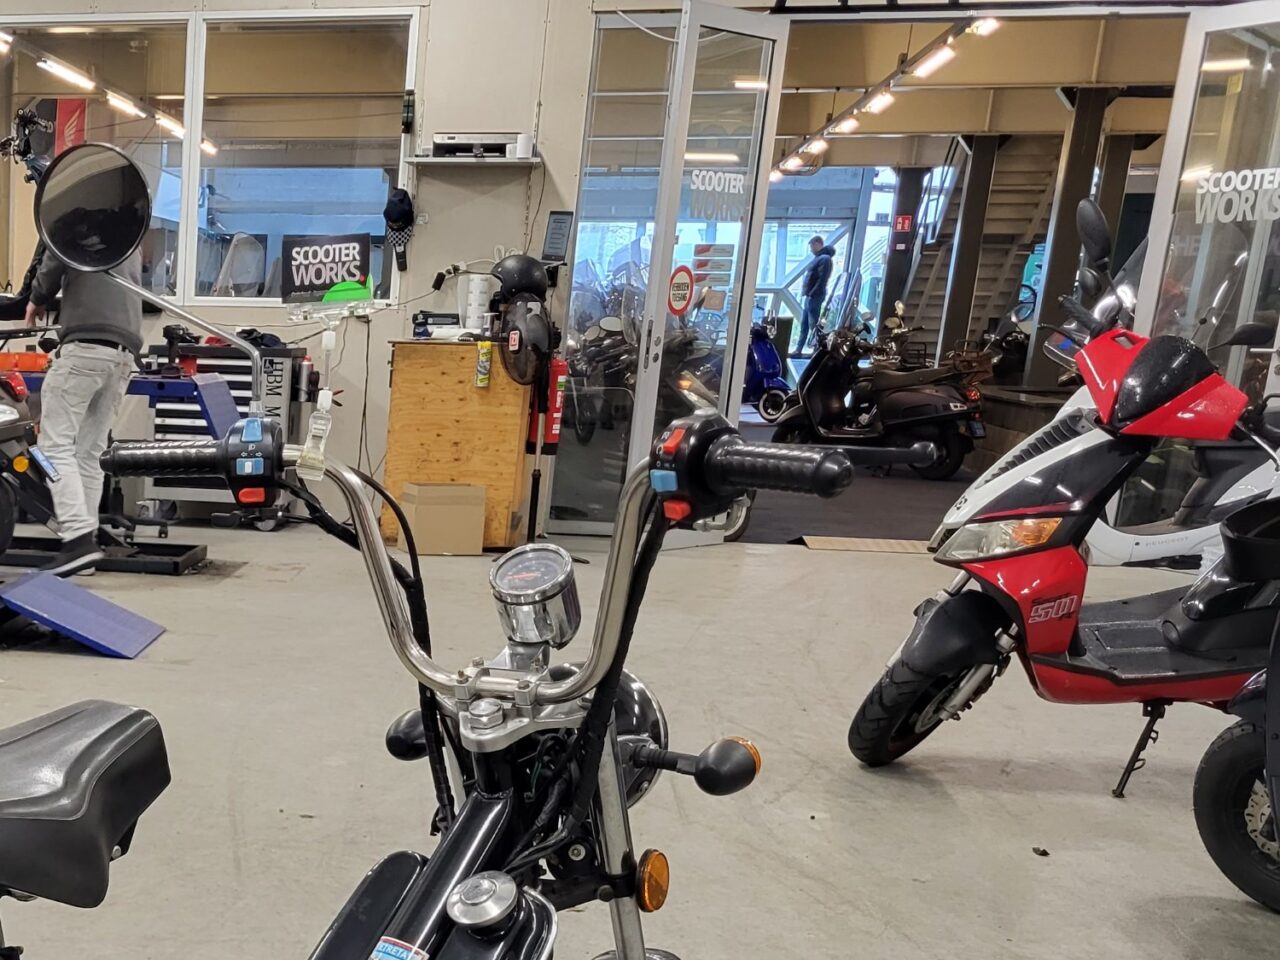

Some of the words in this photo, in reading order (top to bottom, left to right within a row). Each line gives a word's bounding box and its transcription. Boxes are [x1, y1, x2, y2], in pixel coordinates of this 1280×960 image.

[690, 169, 744, 194] SCOOTER
[291, 242, 361, 266] SCOOTER
[266, 360, 284, 397] HBM
